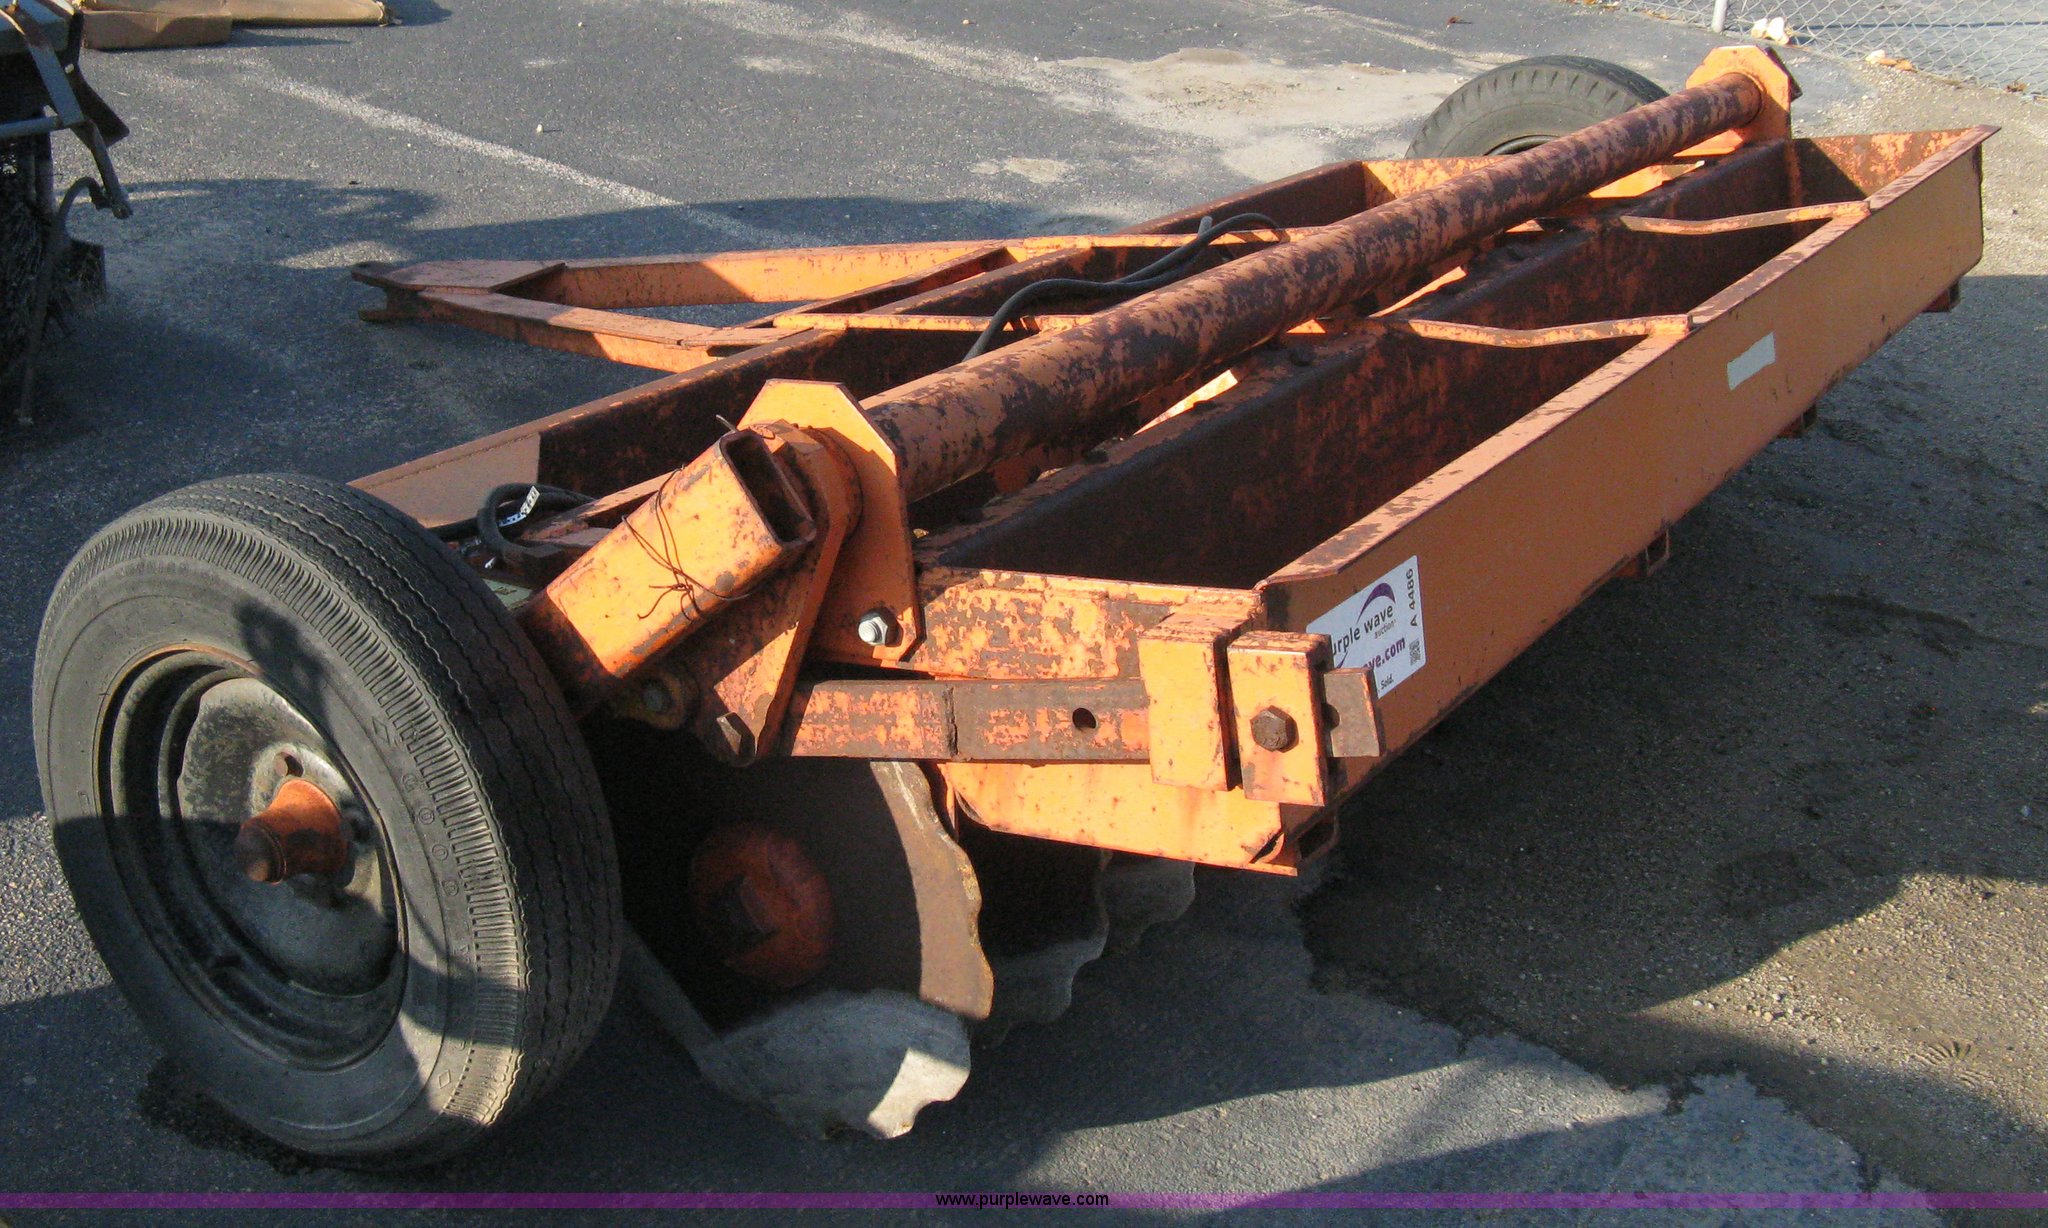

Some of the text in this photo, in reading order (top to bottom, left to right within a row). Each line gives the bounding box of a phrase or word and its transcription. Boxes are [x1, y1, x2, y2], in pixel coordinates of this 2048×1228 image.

[1406, 568, 1418, 627] A 4486
[1331, 605, 1394, 656] urple wave
